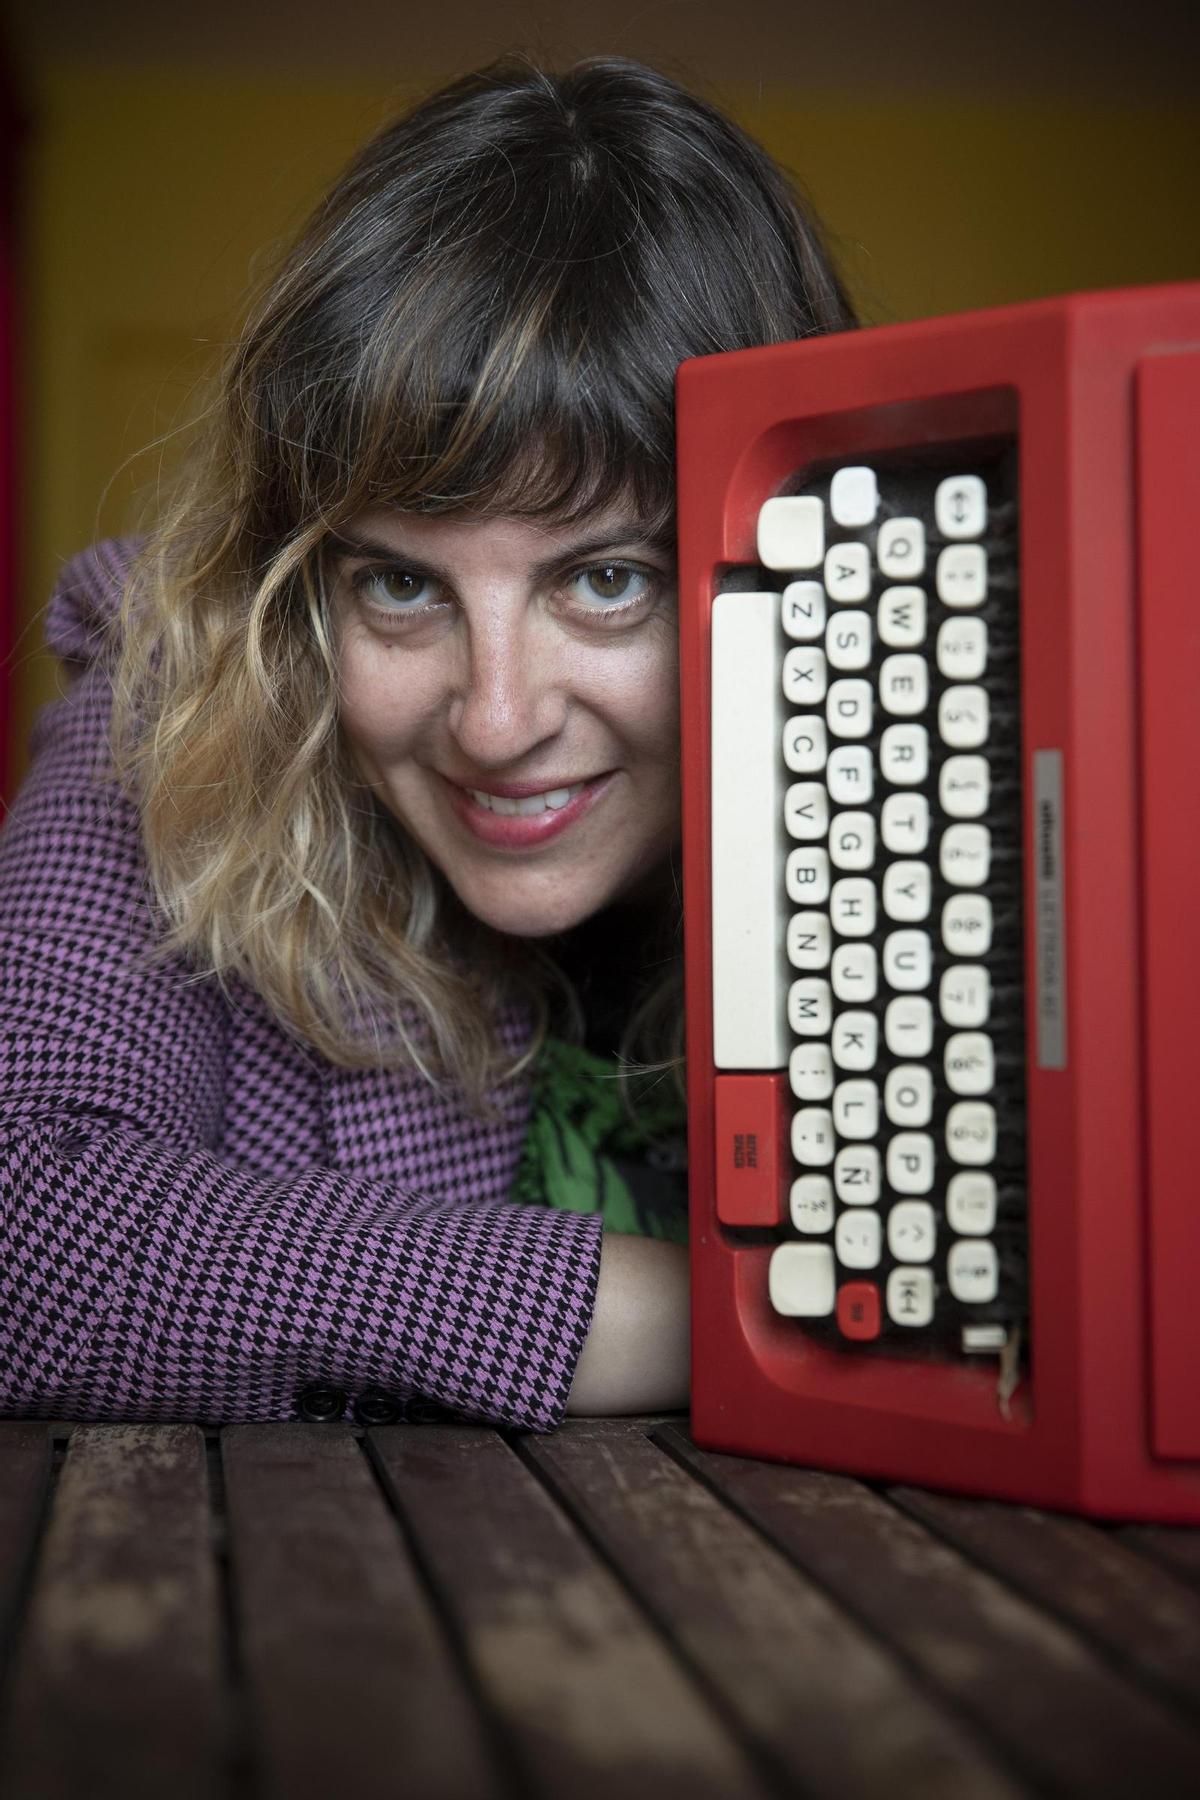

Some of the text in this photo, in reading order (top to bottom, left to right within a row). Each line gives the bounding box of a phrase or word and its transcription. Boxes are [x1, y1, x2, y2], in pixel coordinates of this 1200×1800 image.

[886, 537, 913, 560] Q
[838, 565, 856, 580] A
[792, 602, 812, 618] Z
[891, 602, 912, 630] W
[836, 631, 859, 650] S
[794, 668, 813, 682] X
[891, 675, 914, 691] E
[837, 699, 859, 718] D
[793, 735, 814, 754] C
[894, 745, 914, 762] R
[839, 767, 859, 781] F
[795, 803, 814, 819] V
[895, 815, 915, 831] T
[840, 832, 862, 851] G
[796, 867, 817, 884] B
[897, 883, 915, 898] Y
[842, 899, 861, 916] H
[798, 934, 817, 950] N
[893, 950, 916, 971] U
[842, 966, 864, 980] J
[799, 998, 819, 1018] M
[845, 1032, 863, 1048] K
[895, 1085, 920, 1108] O
[900, 1153, 921, 1173] P
[843, 1168, 870, 1185] Ñ
